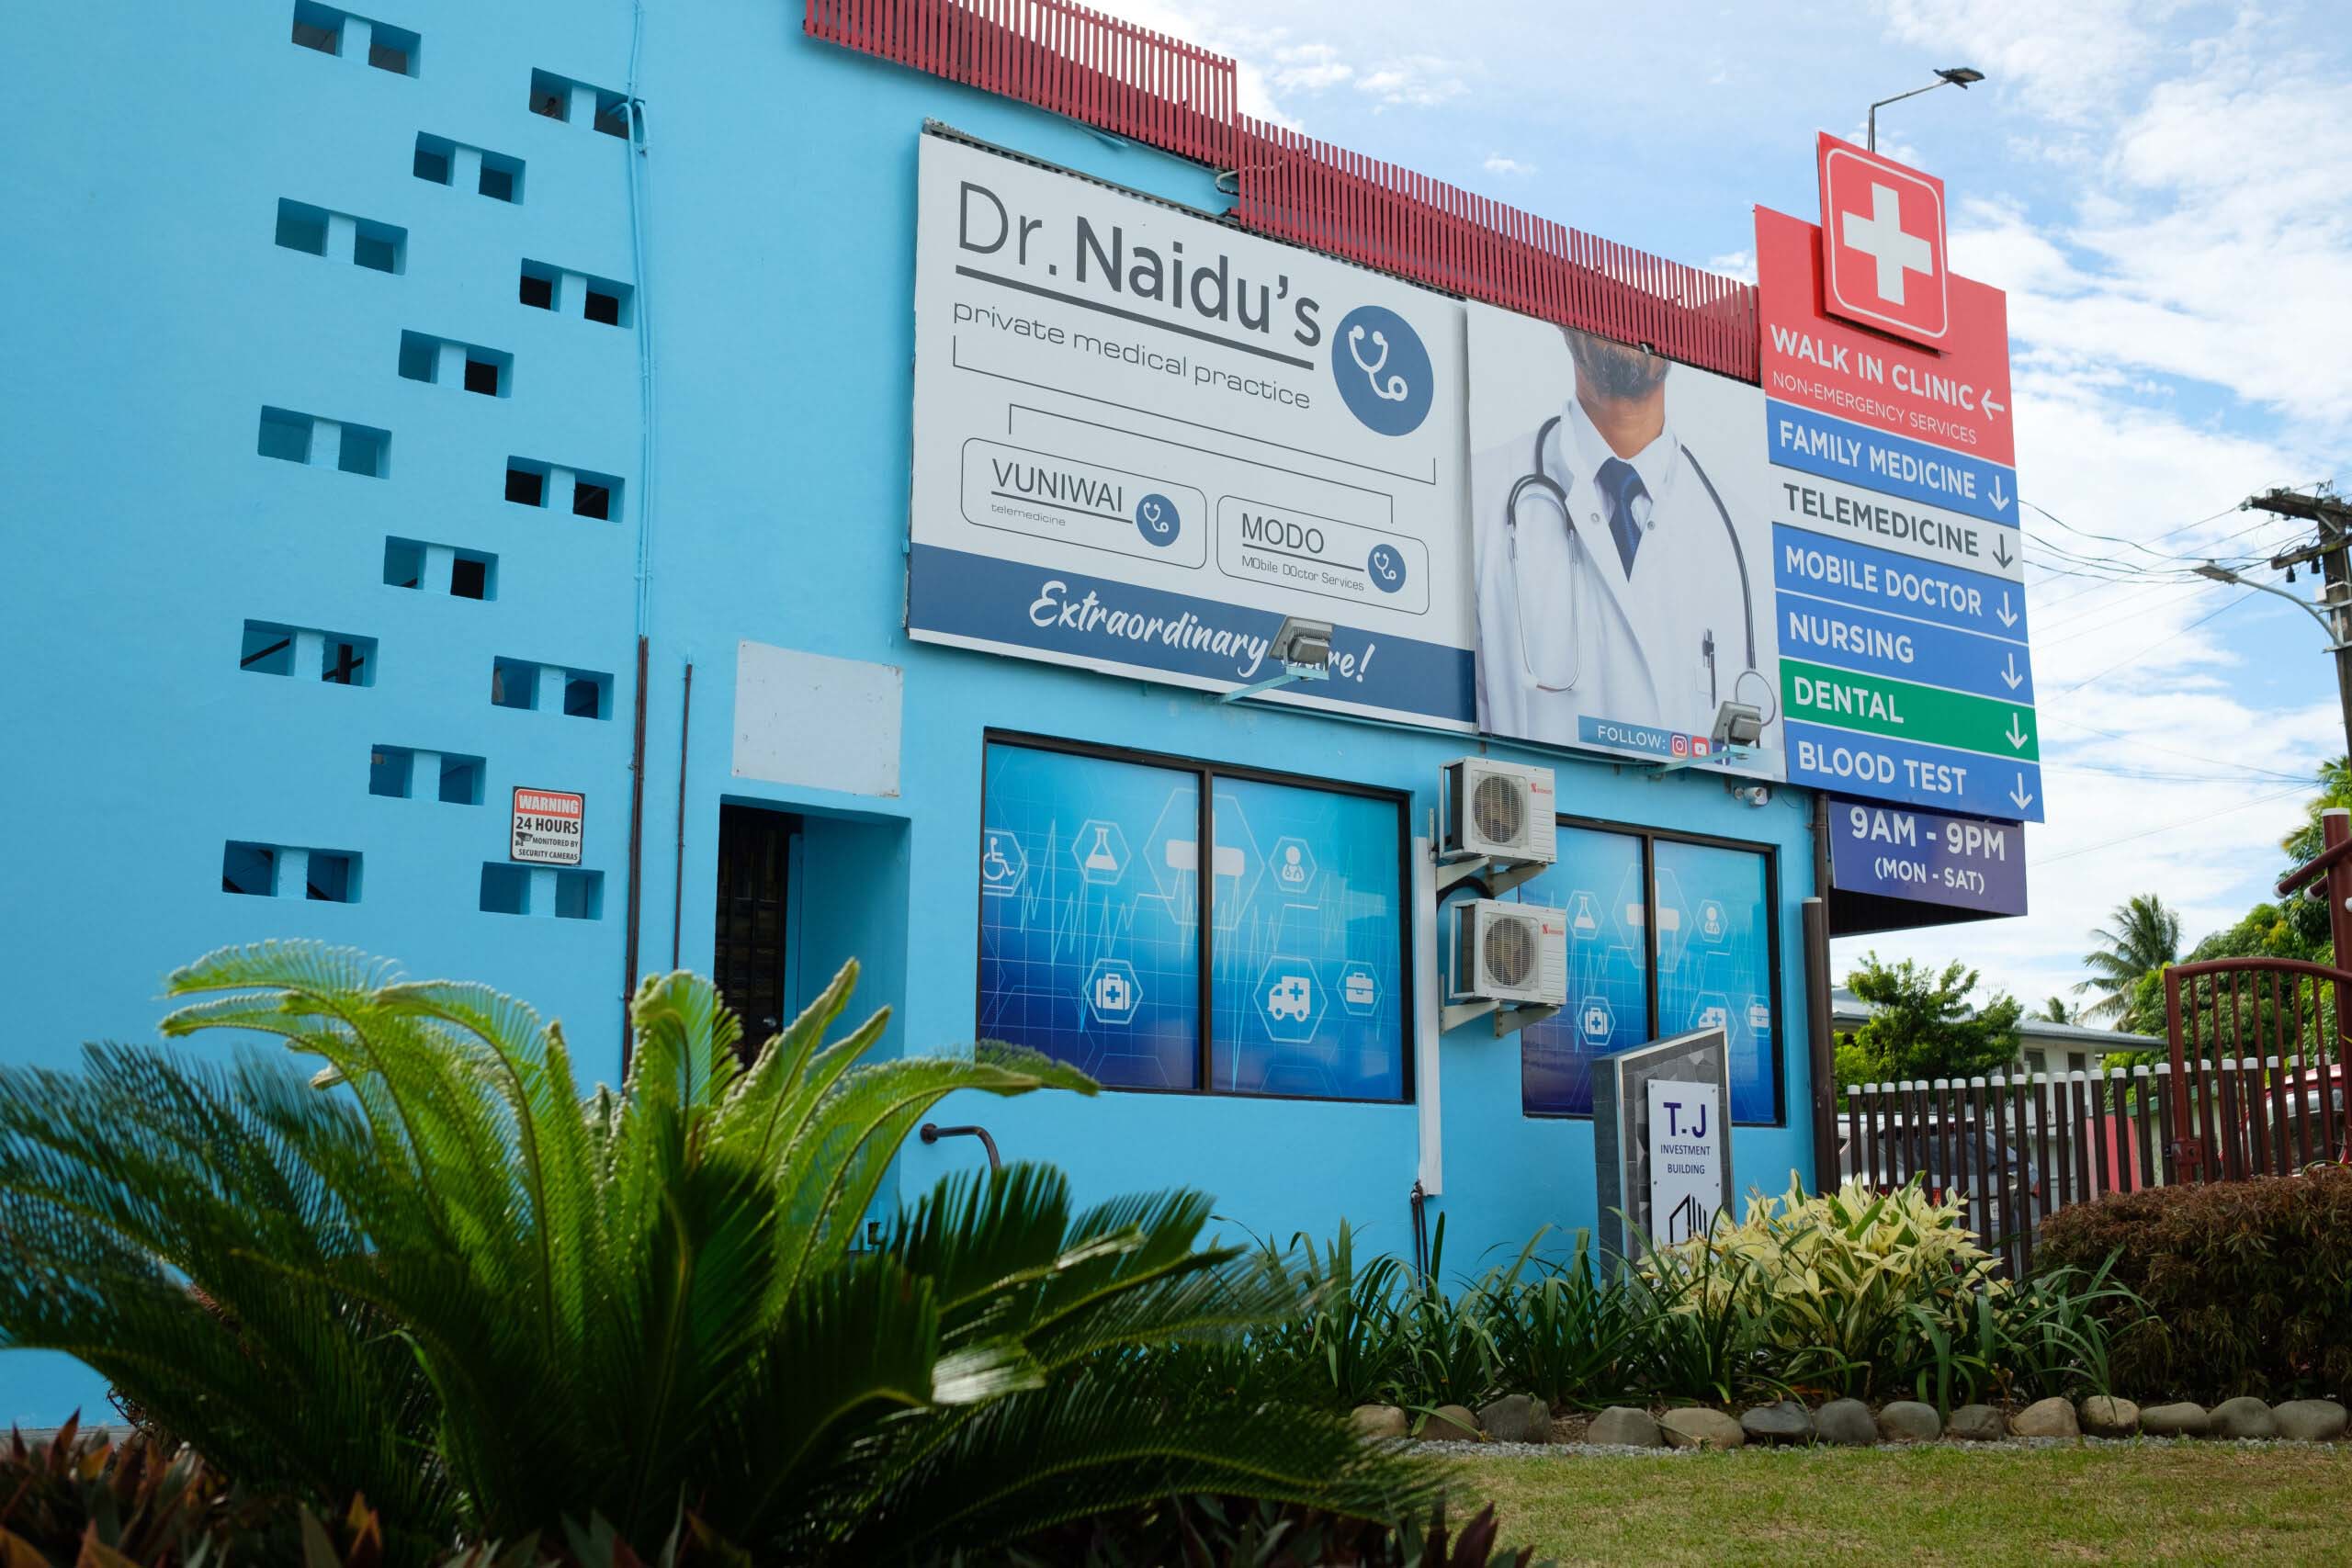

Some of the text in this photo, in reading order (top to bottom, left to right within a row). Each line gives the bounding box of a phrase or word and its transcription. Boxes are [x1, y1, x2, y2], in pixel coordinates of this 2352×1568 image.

[959, 180, 1321, 347] Dr. Naidu's
[954, 301, 1311, 410] private medical practice
[1770, 323, 1974, 411] WALK IN CLINIC
[1772, 371, 1977, 445] NON-EMERGENCY SERVICES
[1780, 420, 1976, 500] FAMILY MEDICINE
[992, 458, 1123, 513] VUNIWAI
[991, 503, 1066, 526] telemedicine
[1242, 513, 1325, 554] MODO
[1783, 482, 1979, 558] TELEMEDICINE
[1322, 572, 1364, 592] Services
[1785, 546, 1983, 617] MOBILE DOCTOR
[1029, 581, 1269, 678] Extraordinary
[1789, 612, 1915, 664] NURSING
[1793, 675, 1905, 724] DENTAL
[1597, 724, 1667, 750] FOLLOW:
[1798, 740, 1967, 795] BLOOD TEST
[515, 816, 579, 835] 24 HOURS
[519, 795, 579, 814] WARNING
[518, 848, 578, 861] SECURITY CAMERAS
[532, 837, 570, 847] MONITORED
[1849, 807, 1917, 847] 9AM
[1946, 821, 2006, 862] 9PM
[1874, 857, 1927, 884] (MON
[1944, 868, 1984, 895] SAT)
[1663, 1101, 1707, 1138] T.J
[1660, 1144, 1711, 1156] INVESTMENT
[1667, 1163, 1705, 1175] BUILDING
